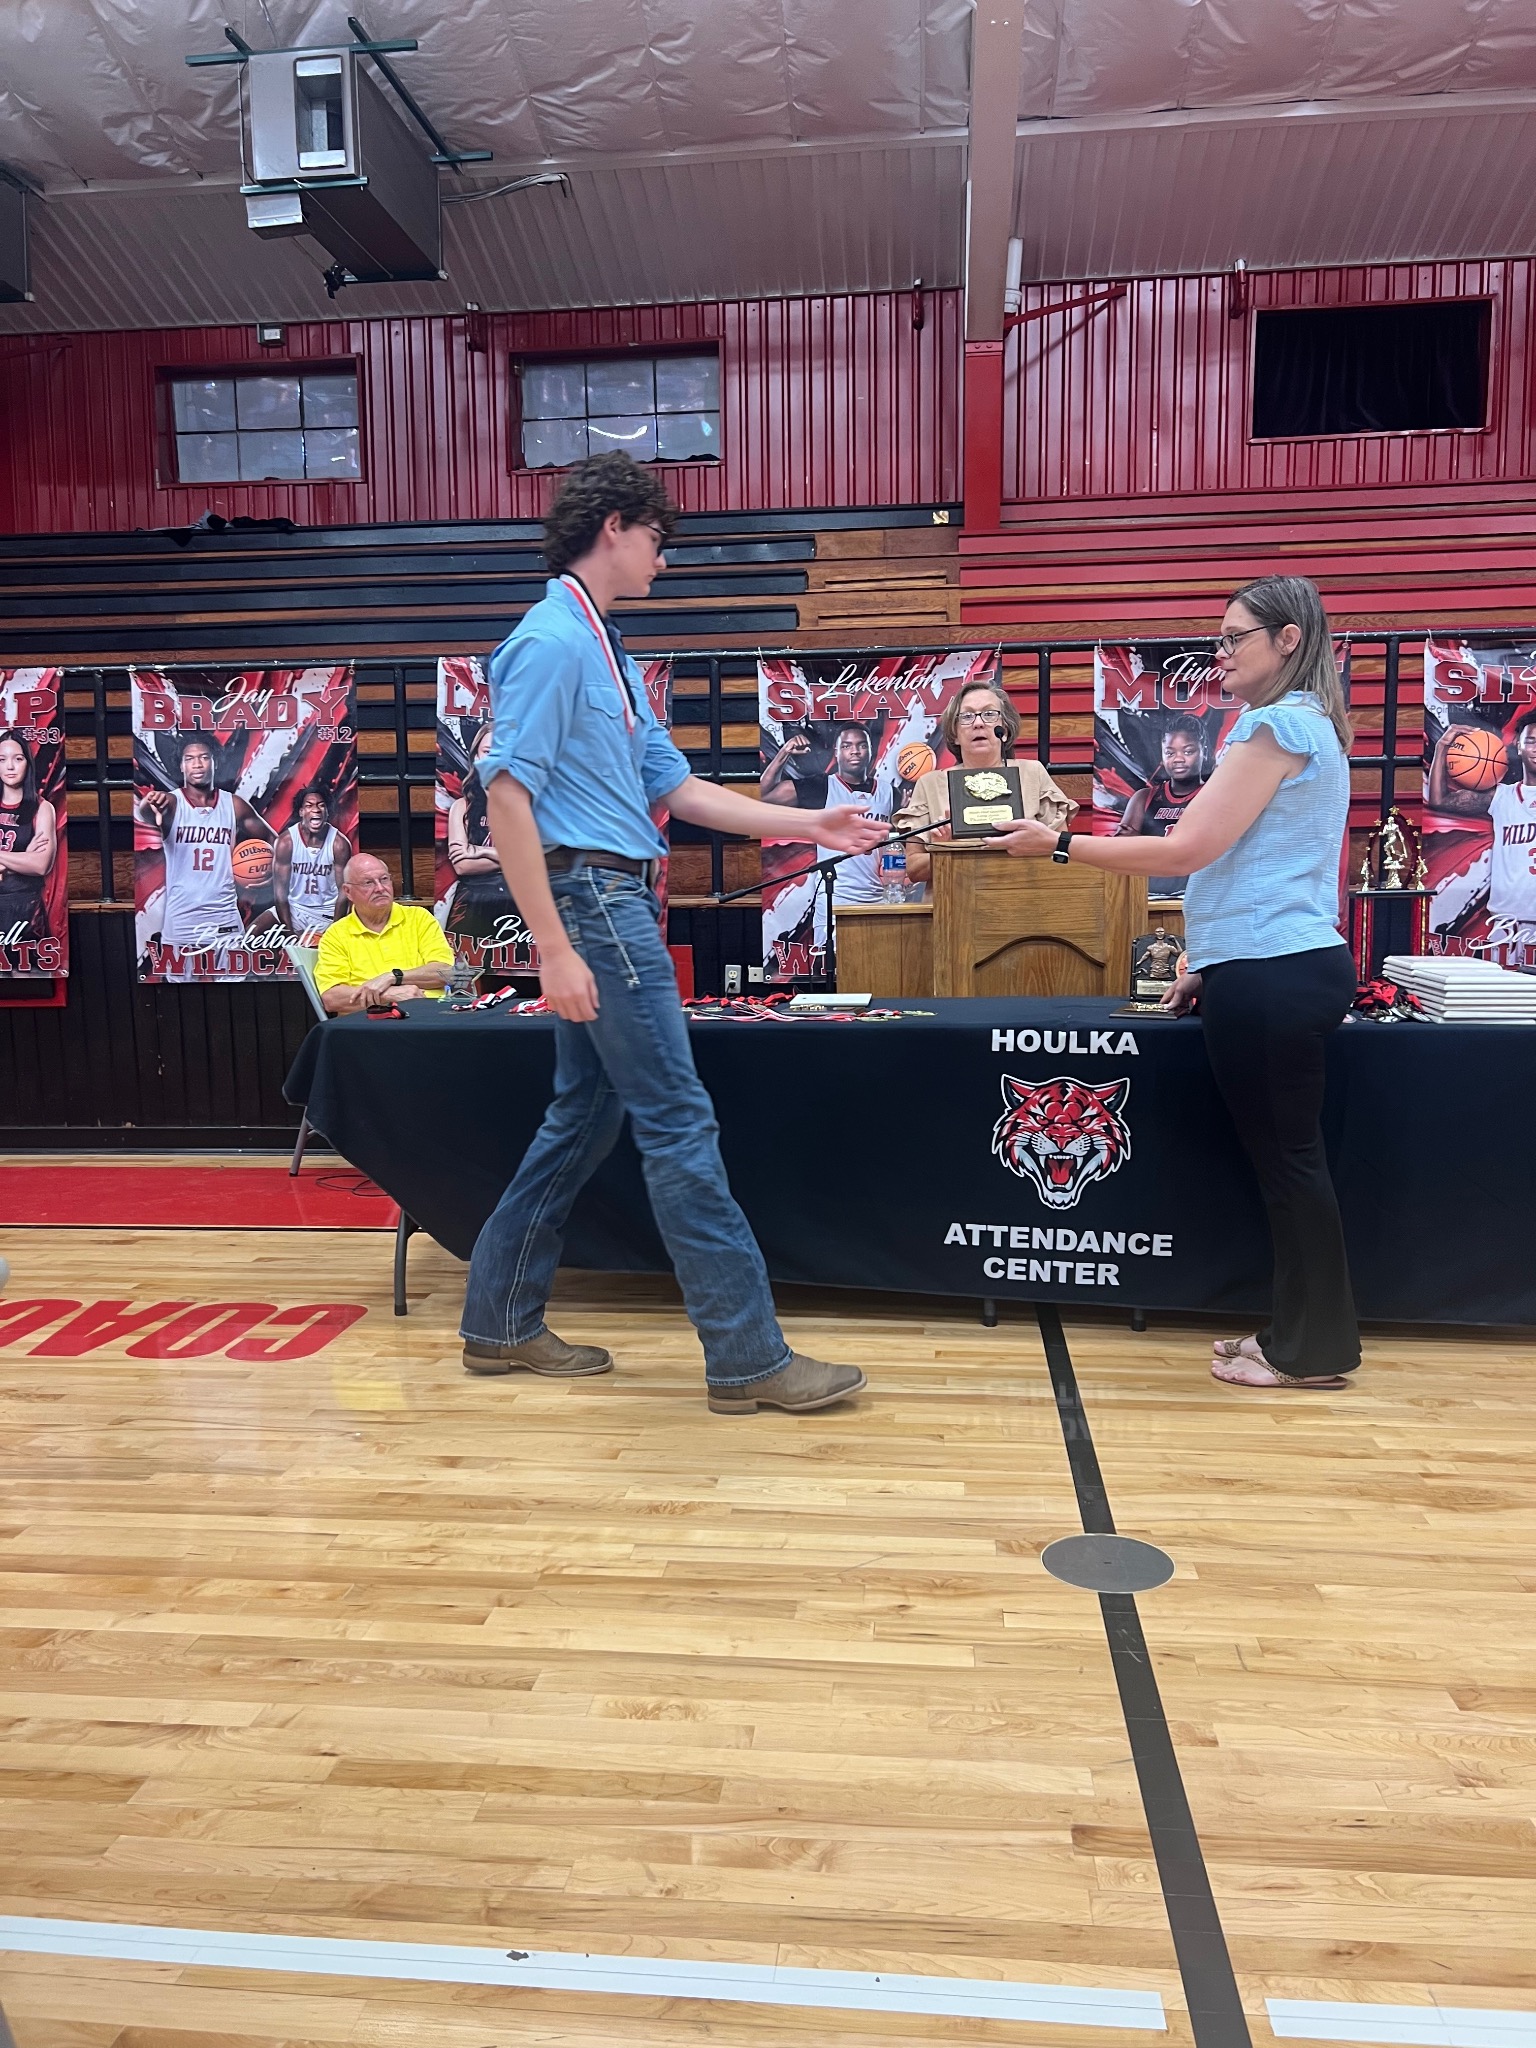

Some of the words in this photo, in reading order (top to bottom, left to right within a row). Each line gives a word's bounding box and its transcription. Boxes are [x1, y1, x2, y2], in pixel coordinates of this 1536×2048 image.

[816, 663, 939, 703] Lakenton
[140, 686, 350, 731] BRADY
[212, 676, 275, 718] Jay
[22, 727, 61, 745] #33
[317, 726, 352, 744] #12
[175, 826, 232, 846] WILDCATS
[192, 848, 215, 872] 12
[239, 846, 272, 859] Wilson
[292, 862, 333, 877] WILDCATS
[304, 879, 320, 895] 12
[180, 922, 320, 957] Basketball
[991, 1028, 1140, 1055] HOULKA
[943, 1222, 1174, 1257] ATTENDANCE
[983, 1257, 1121, 1286] CENTER
